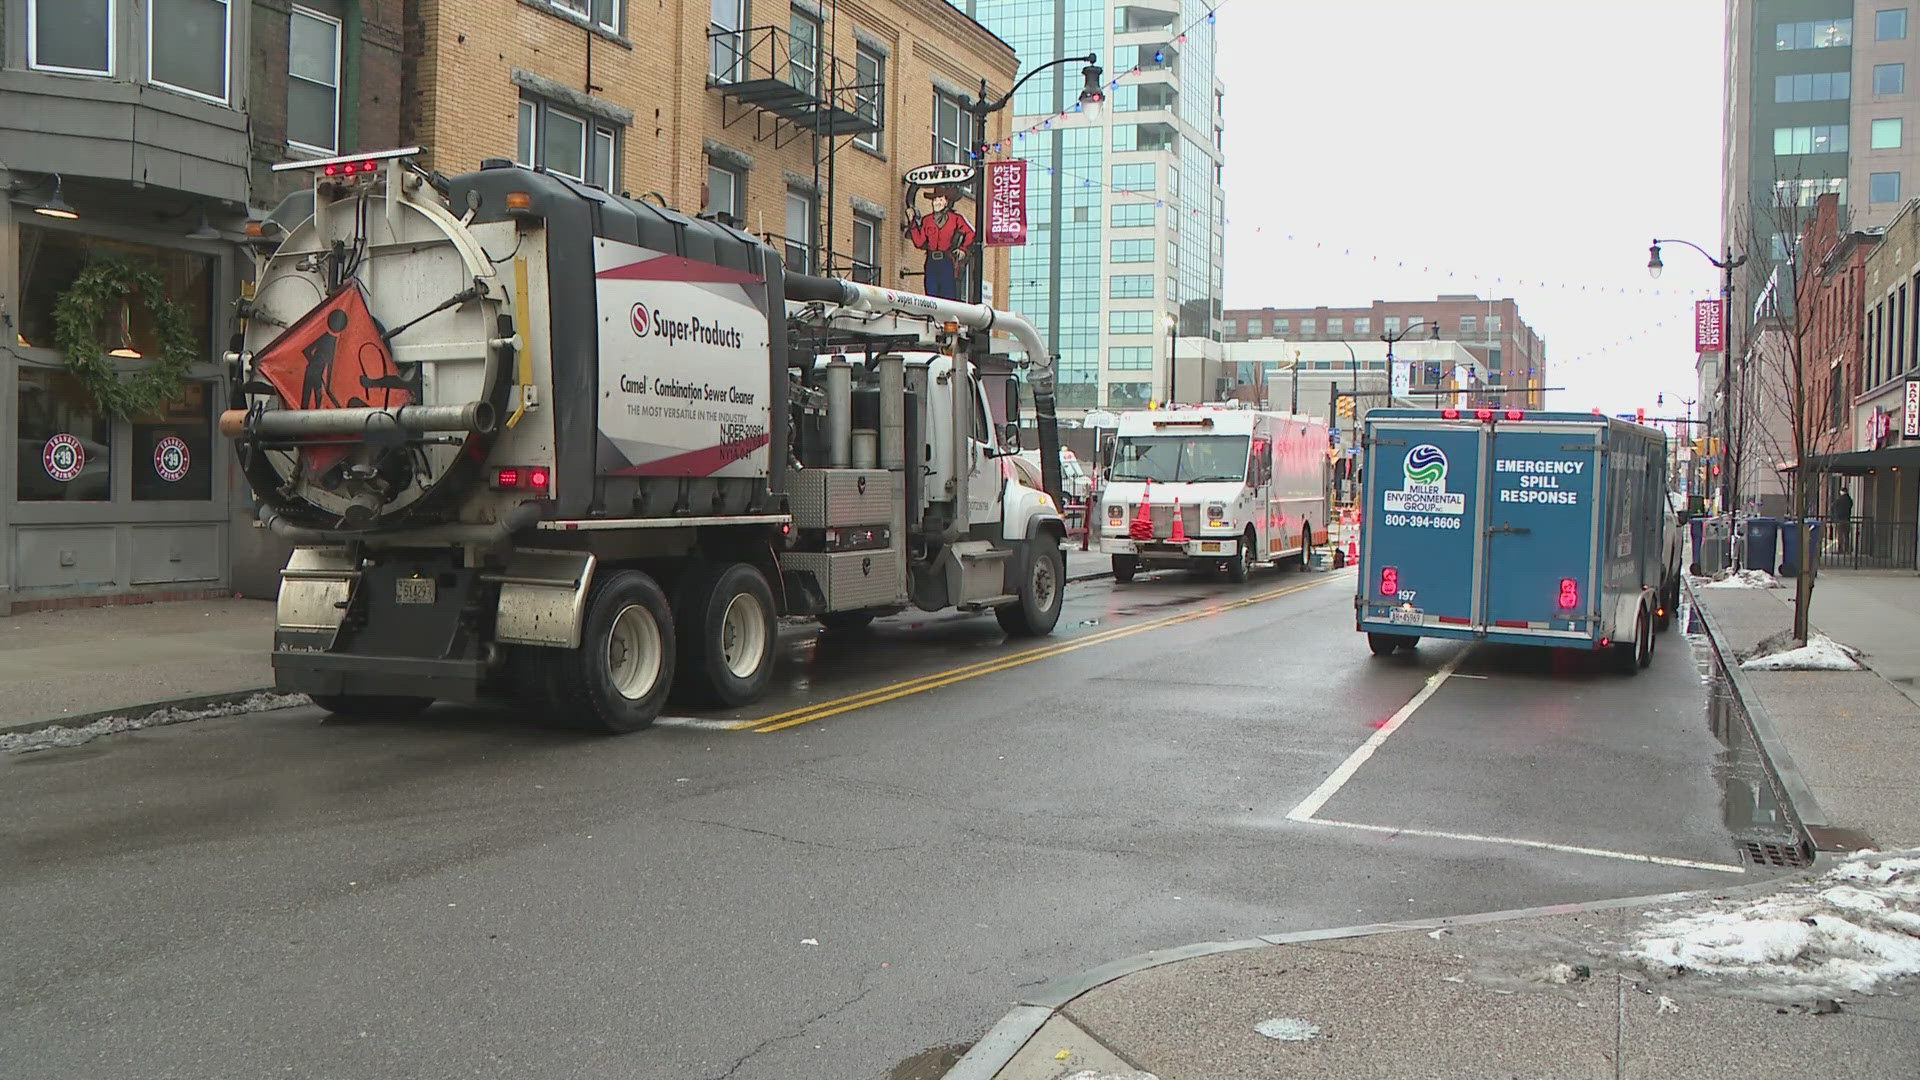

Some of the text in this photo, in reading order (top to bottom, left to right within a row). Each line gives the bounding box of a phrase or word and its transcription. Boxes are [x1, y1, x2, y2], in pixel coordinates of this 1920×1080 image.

[909, 168, 971, 181] COWBOY
[992, 165, 1003, 233] BUFFALO'S
[1002, 165, 1010, 233] ENTERTAINMENT
[1009, 164, 1021, 233] DISTRICT
[1710, 301, 1720, 345] DISTRICT
[620, 374, 647, 395] Camel
[654, 378, 703, 401] Combination
[704, 383, 727, 403] Sewer
[728, 385, 755, 405] Cleaner
[627, 404, 748, 424] THE MOST VERSATILE IN THE INDUSTRY
[1495, 459, 1584, 475] EMERGENCY
[1409, 485, 1440, 495] MILLER
[1520, 475, 1560, 489] SPILL
[1387, 493, 1462, 505] ENVIRONMENTAL
[1500, 489, 1578, 505] RESPONSE
[1403, 502, 1436, 512] GROUP
[1384, 513, 1461, 530] 800-394-8606
[1397, 590, 1417, 601] 197
